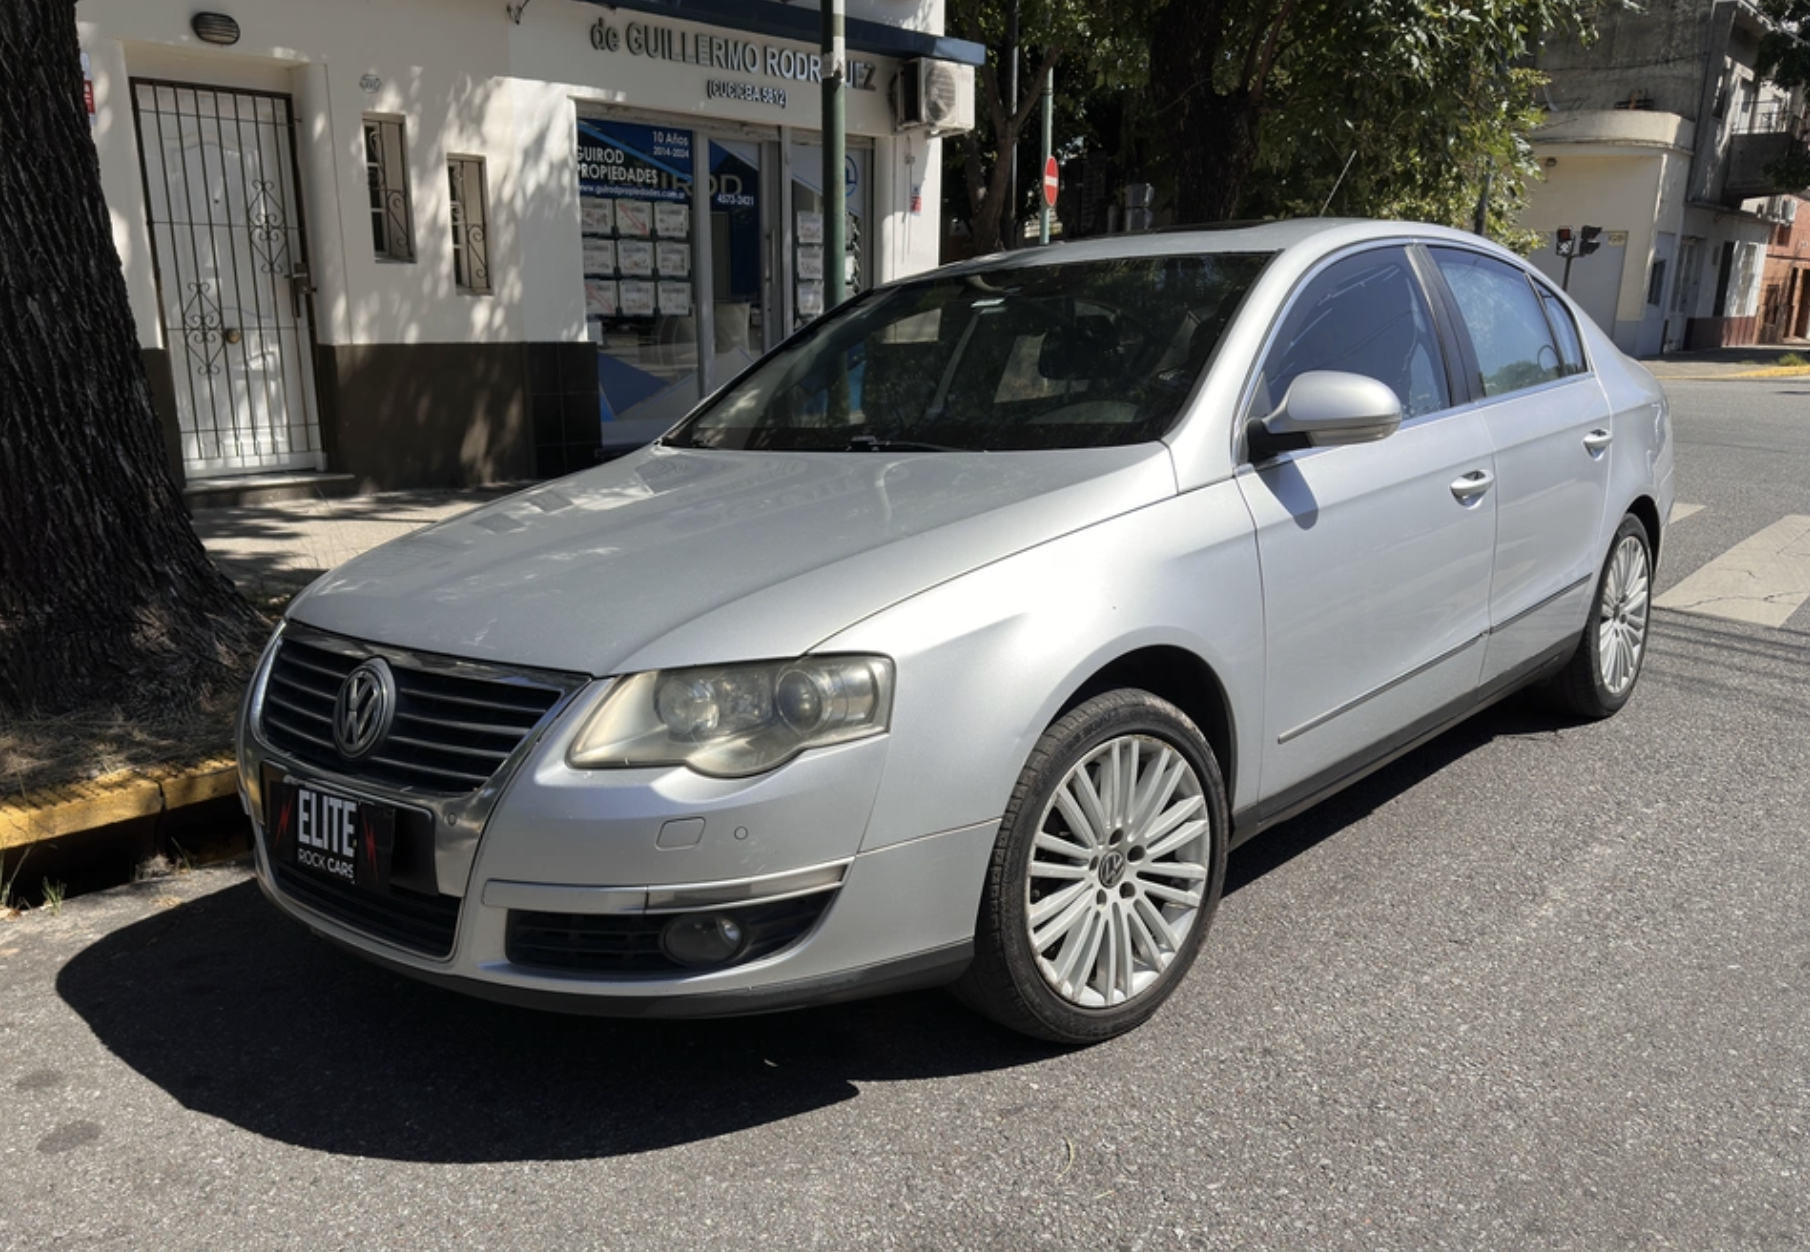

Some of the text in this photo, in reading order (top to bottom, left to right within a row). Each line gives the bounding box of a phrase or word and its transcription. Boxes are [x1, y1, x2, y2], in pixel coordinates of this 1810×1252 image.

[589, 17, 877, 92] de GUILLERMO RODRUEZ
[652, 131, 664, 144] 10
[298, 789, 356, 857] ELITE
[298, 848, 354, 879] ROCK CARS
